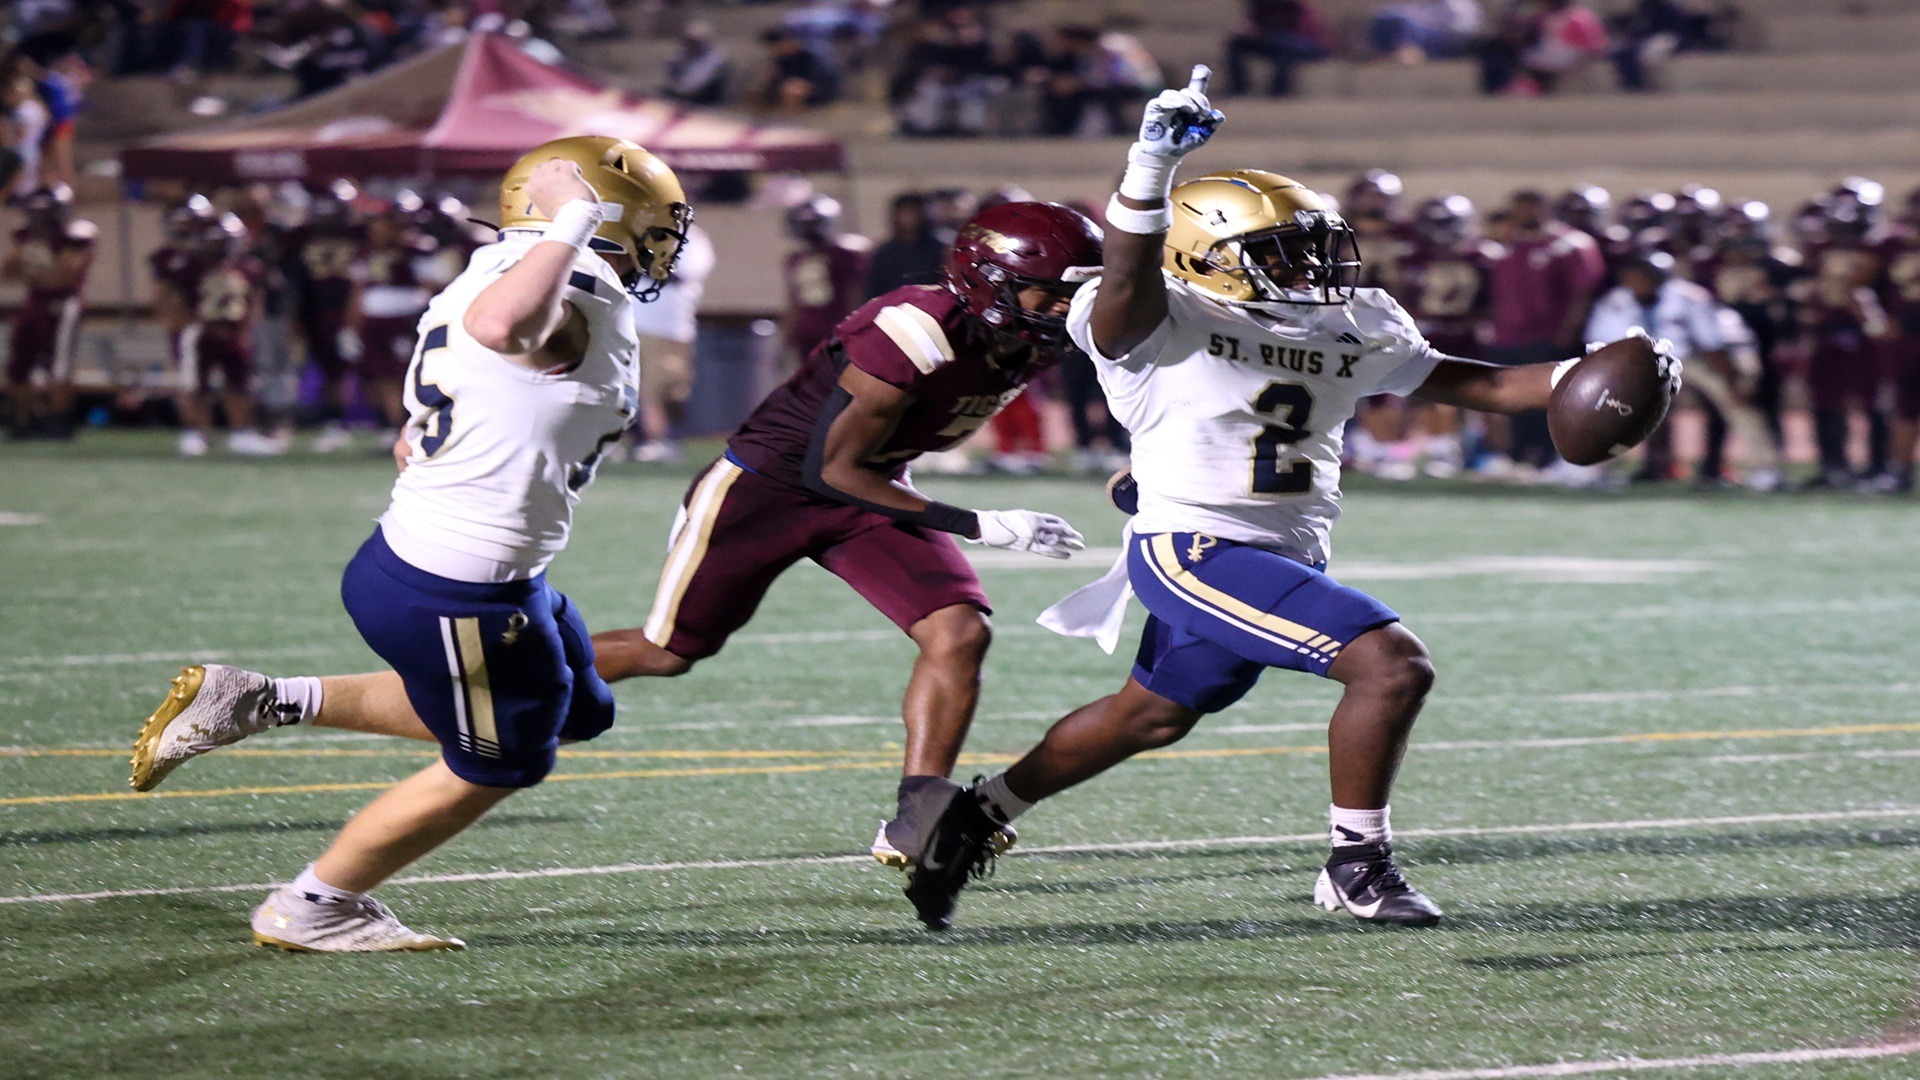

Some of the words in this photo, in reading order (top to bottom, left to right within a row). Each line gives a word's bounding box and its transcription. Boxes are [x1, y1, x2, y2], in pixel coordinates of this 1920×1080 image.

[1208, 333, 1248, 362] ST.
[1259, 343, 1325, 375] PIUS
[1336, 354, 1360, 378] X
[950, 382, 1028, 416] TIG
[1247, 379, 1316, 498] 2
